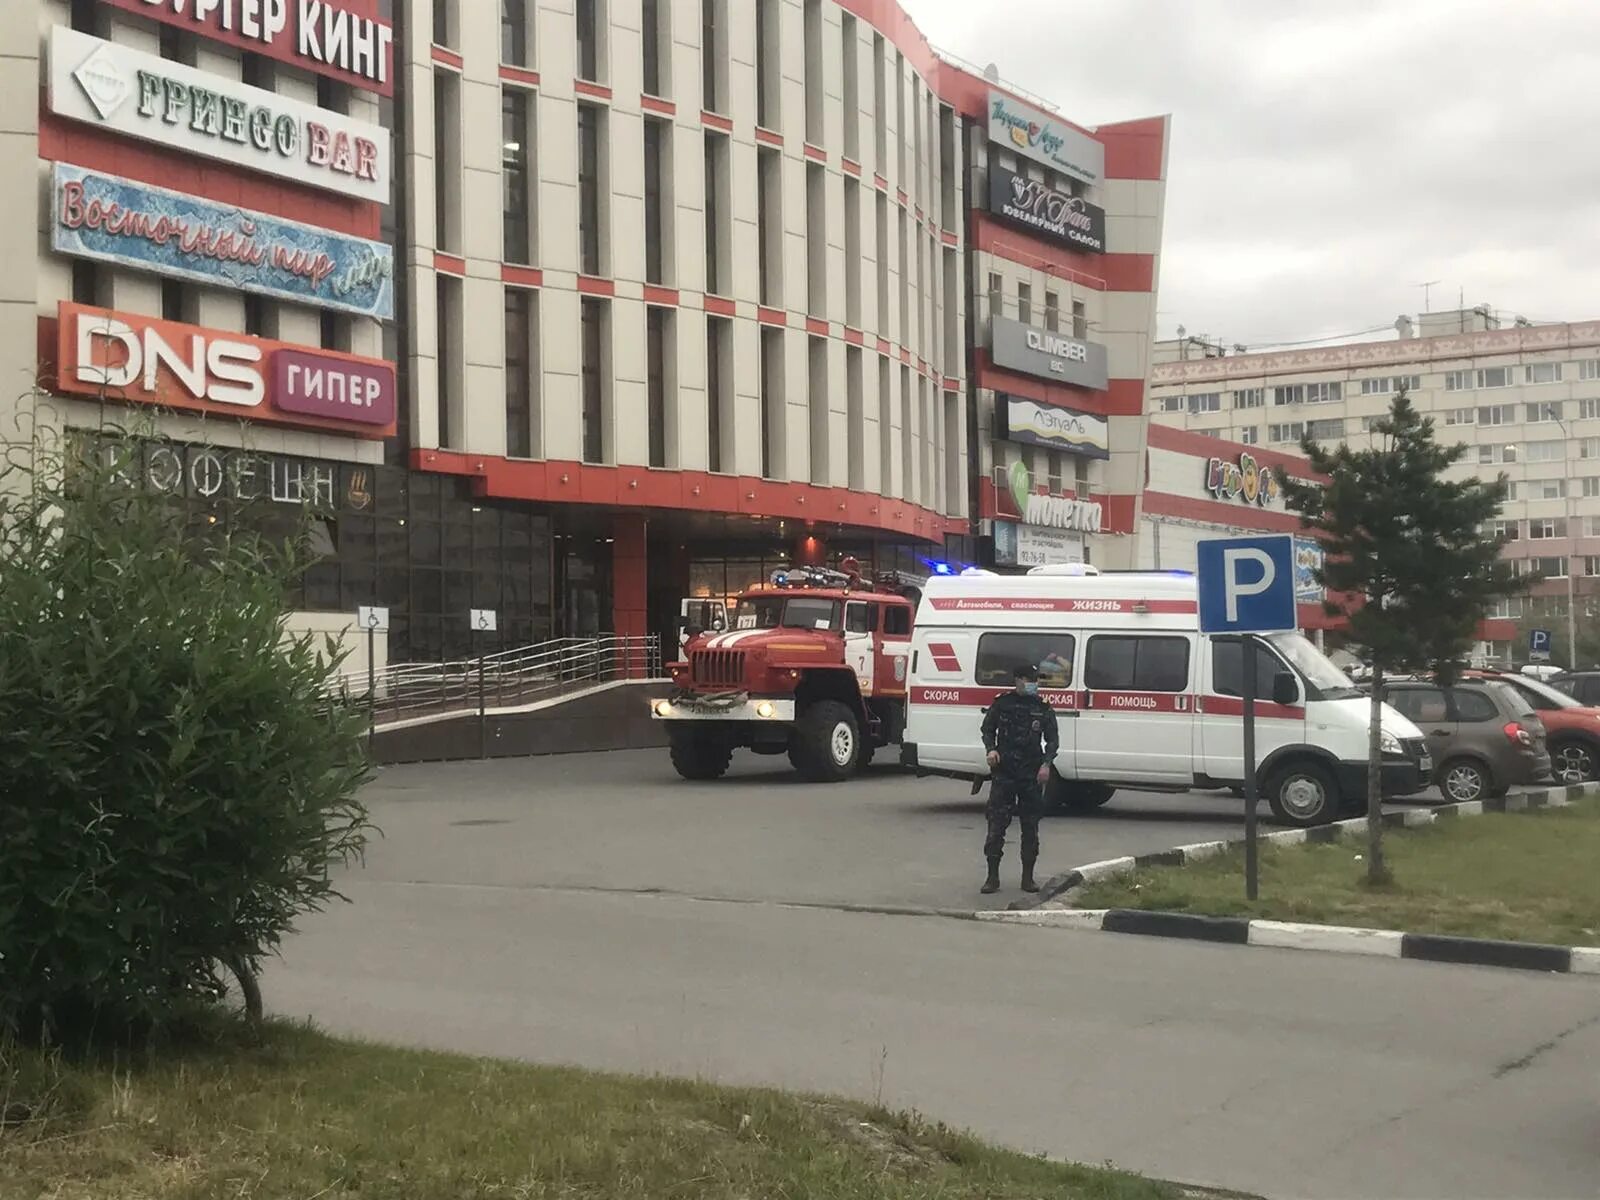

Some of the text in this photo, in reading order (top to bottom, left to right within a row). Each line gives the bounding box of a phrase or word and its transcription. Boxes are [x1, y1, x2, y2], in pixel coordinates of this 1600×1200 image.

[299, 0, 393, 82] КИНГ
[307, 121, 379, 181] BAR
[63, 181, 267, 267] Восточный
[273, 246, 336, 290] пир
[1068, 230, 1100, 248] САЛОН
[76, 312, 265, 407] DNS
[1027, 330, 1087, 362] CLIMBER
[287, 364, 381, 407] ГИПЕР
[1071, 600, 1122, 611] ЖИЗНЬ
[1224, 548, 1275, 622] P
[1533, 631, 1547, 648] P
[923, 690, 959, 702] СКОРАЯ
[1110, 695, 1157, 708] ПОМОЩЬ
